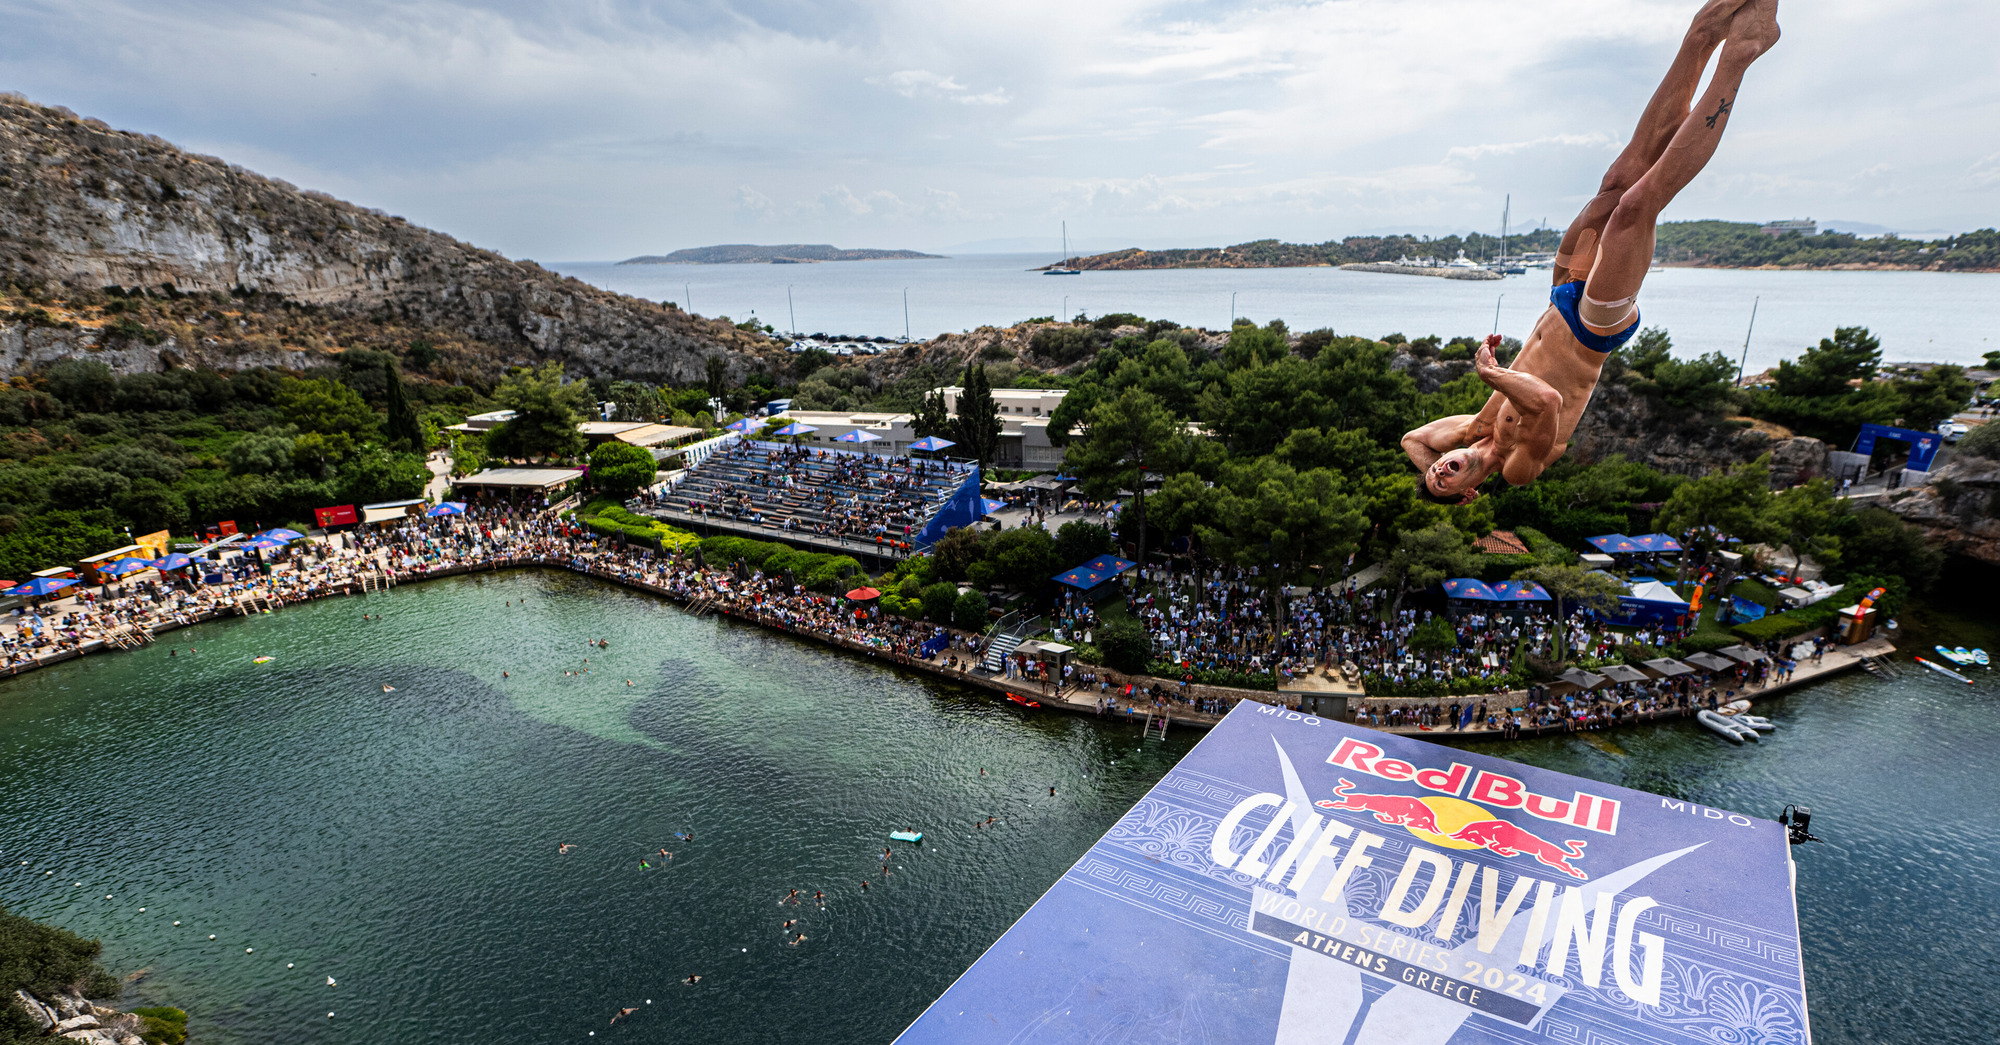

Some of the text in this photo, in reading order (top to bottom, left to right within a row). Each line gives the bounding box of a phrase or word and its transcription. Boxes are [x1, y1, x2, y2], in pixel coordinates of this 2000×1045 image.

[1256, 705, 1320, 726] MIDO
[1328, 738, 1619, 834] Red Bull
[1661, 798, 1753, 828] MIDO
[1211, 792, 1665, 1008] CLIFF DIVING
[1259, 892, 1547, 1005] WORLD SERIES 2024
[1293, 930, 1482, 1006] ATHENS GREECE
